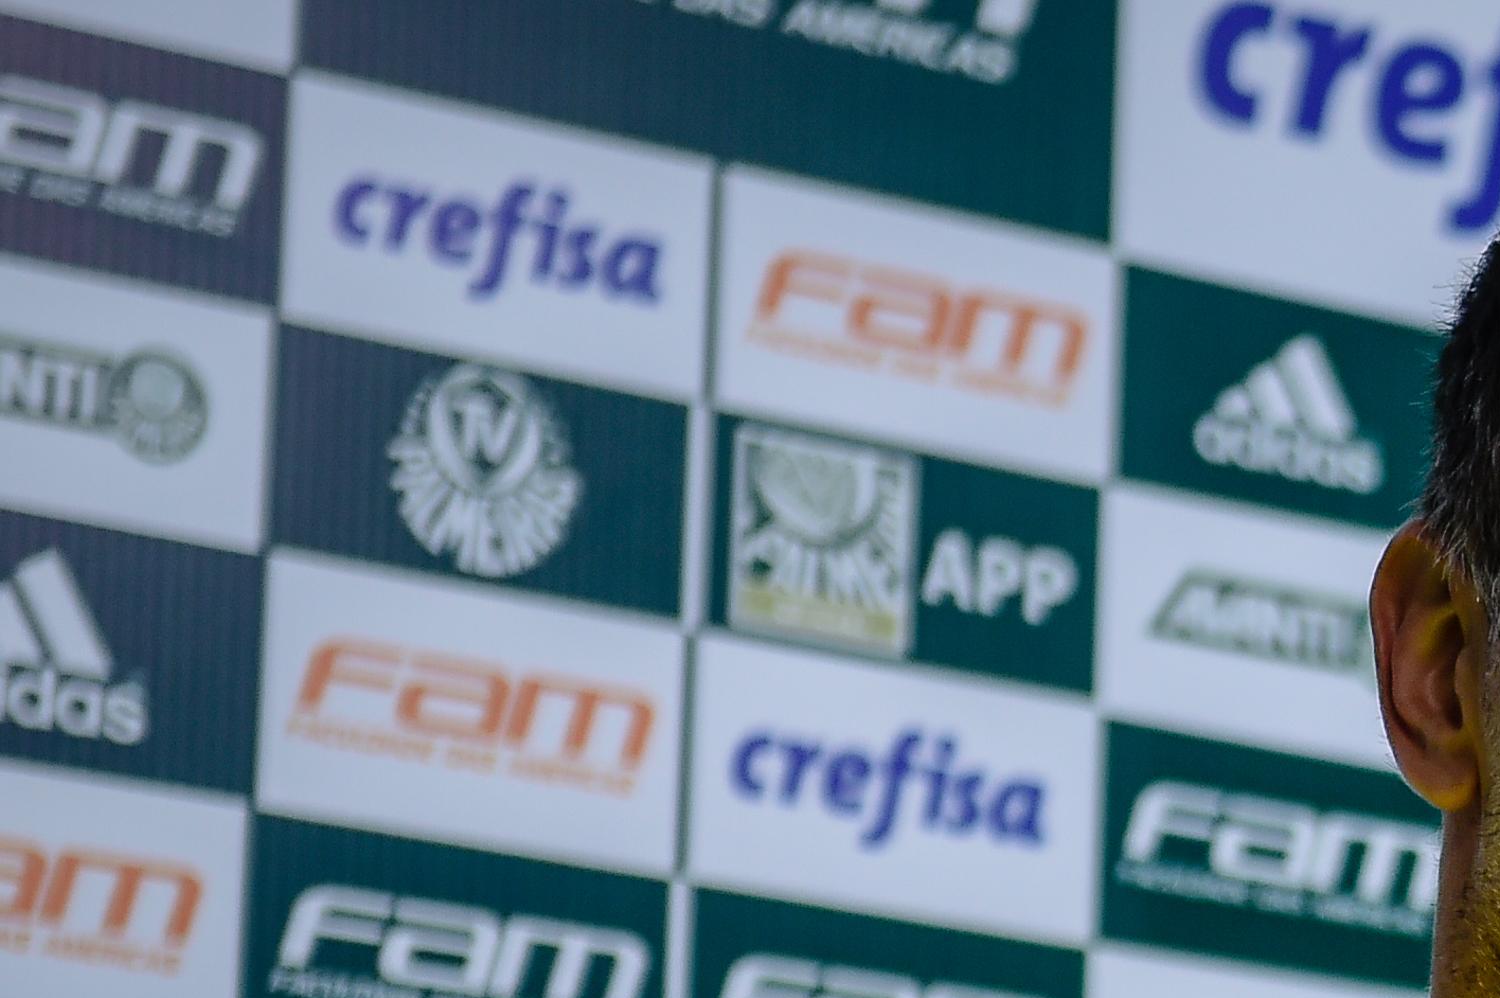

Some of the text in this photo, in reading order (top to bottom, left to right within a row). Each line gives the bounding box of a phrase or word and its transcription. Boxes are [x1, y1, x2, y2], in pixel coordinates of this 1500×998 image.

[333, 175, 663, 302] crefisa
[754, 247, 1090, 385] Fam
[922, 527, 1079, 625] APP
[296, 636, 657, 775] Fam
[733, 728, 1047, 851] crefisa
[1122, 780, 1441, 912] Fam
